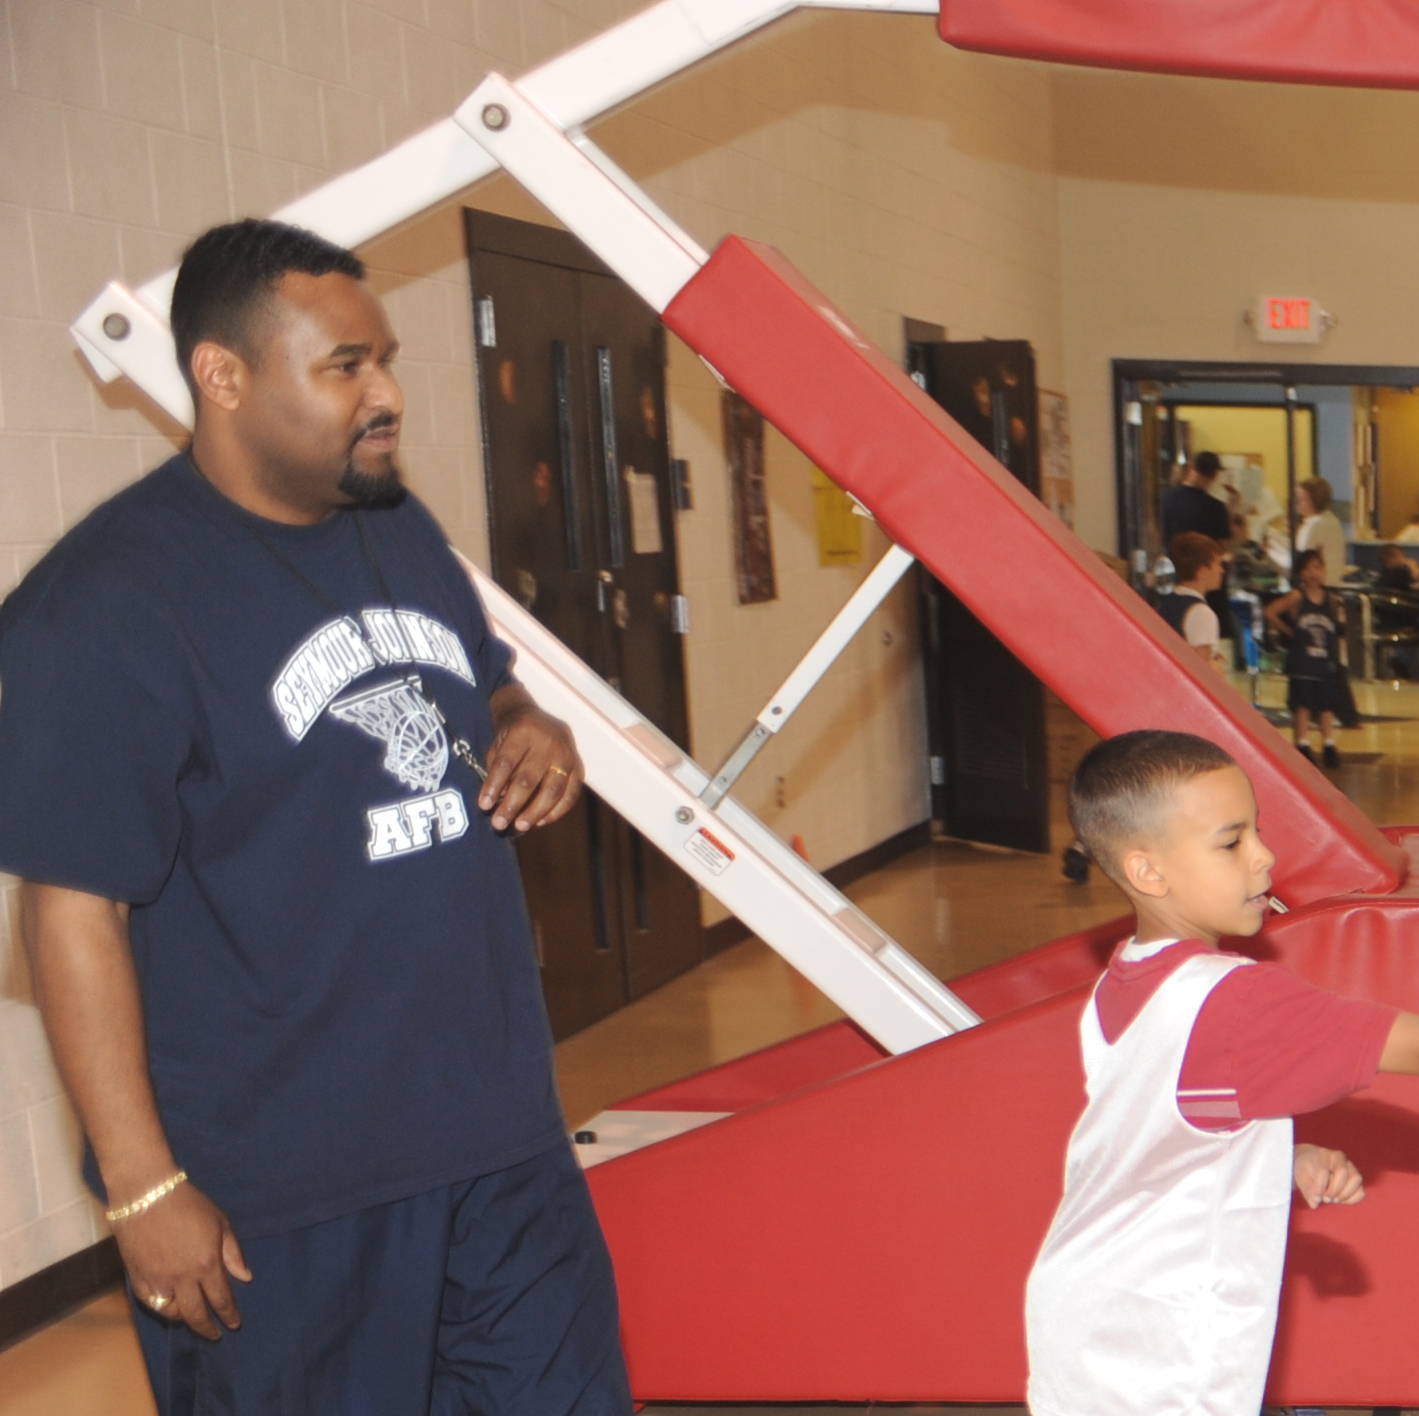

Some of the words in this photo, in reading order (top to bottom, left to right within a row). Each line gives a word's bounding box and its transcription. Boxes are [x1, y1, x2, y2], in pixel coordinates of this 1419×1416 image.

[1266, 297, 1311, 331] EXIT
[273, 616, 375, 740] SEYMOUR
[361, 609, 476, 686] JOHNSON
[366, 788, 469, 860] AFB
